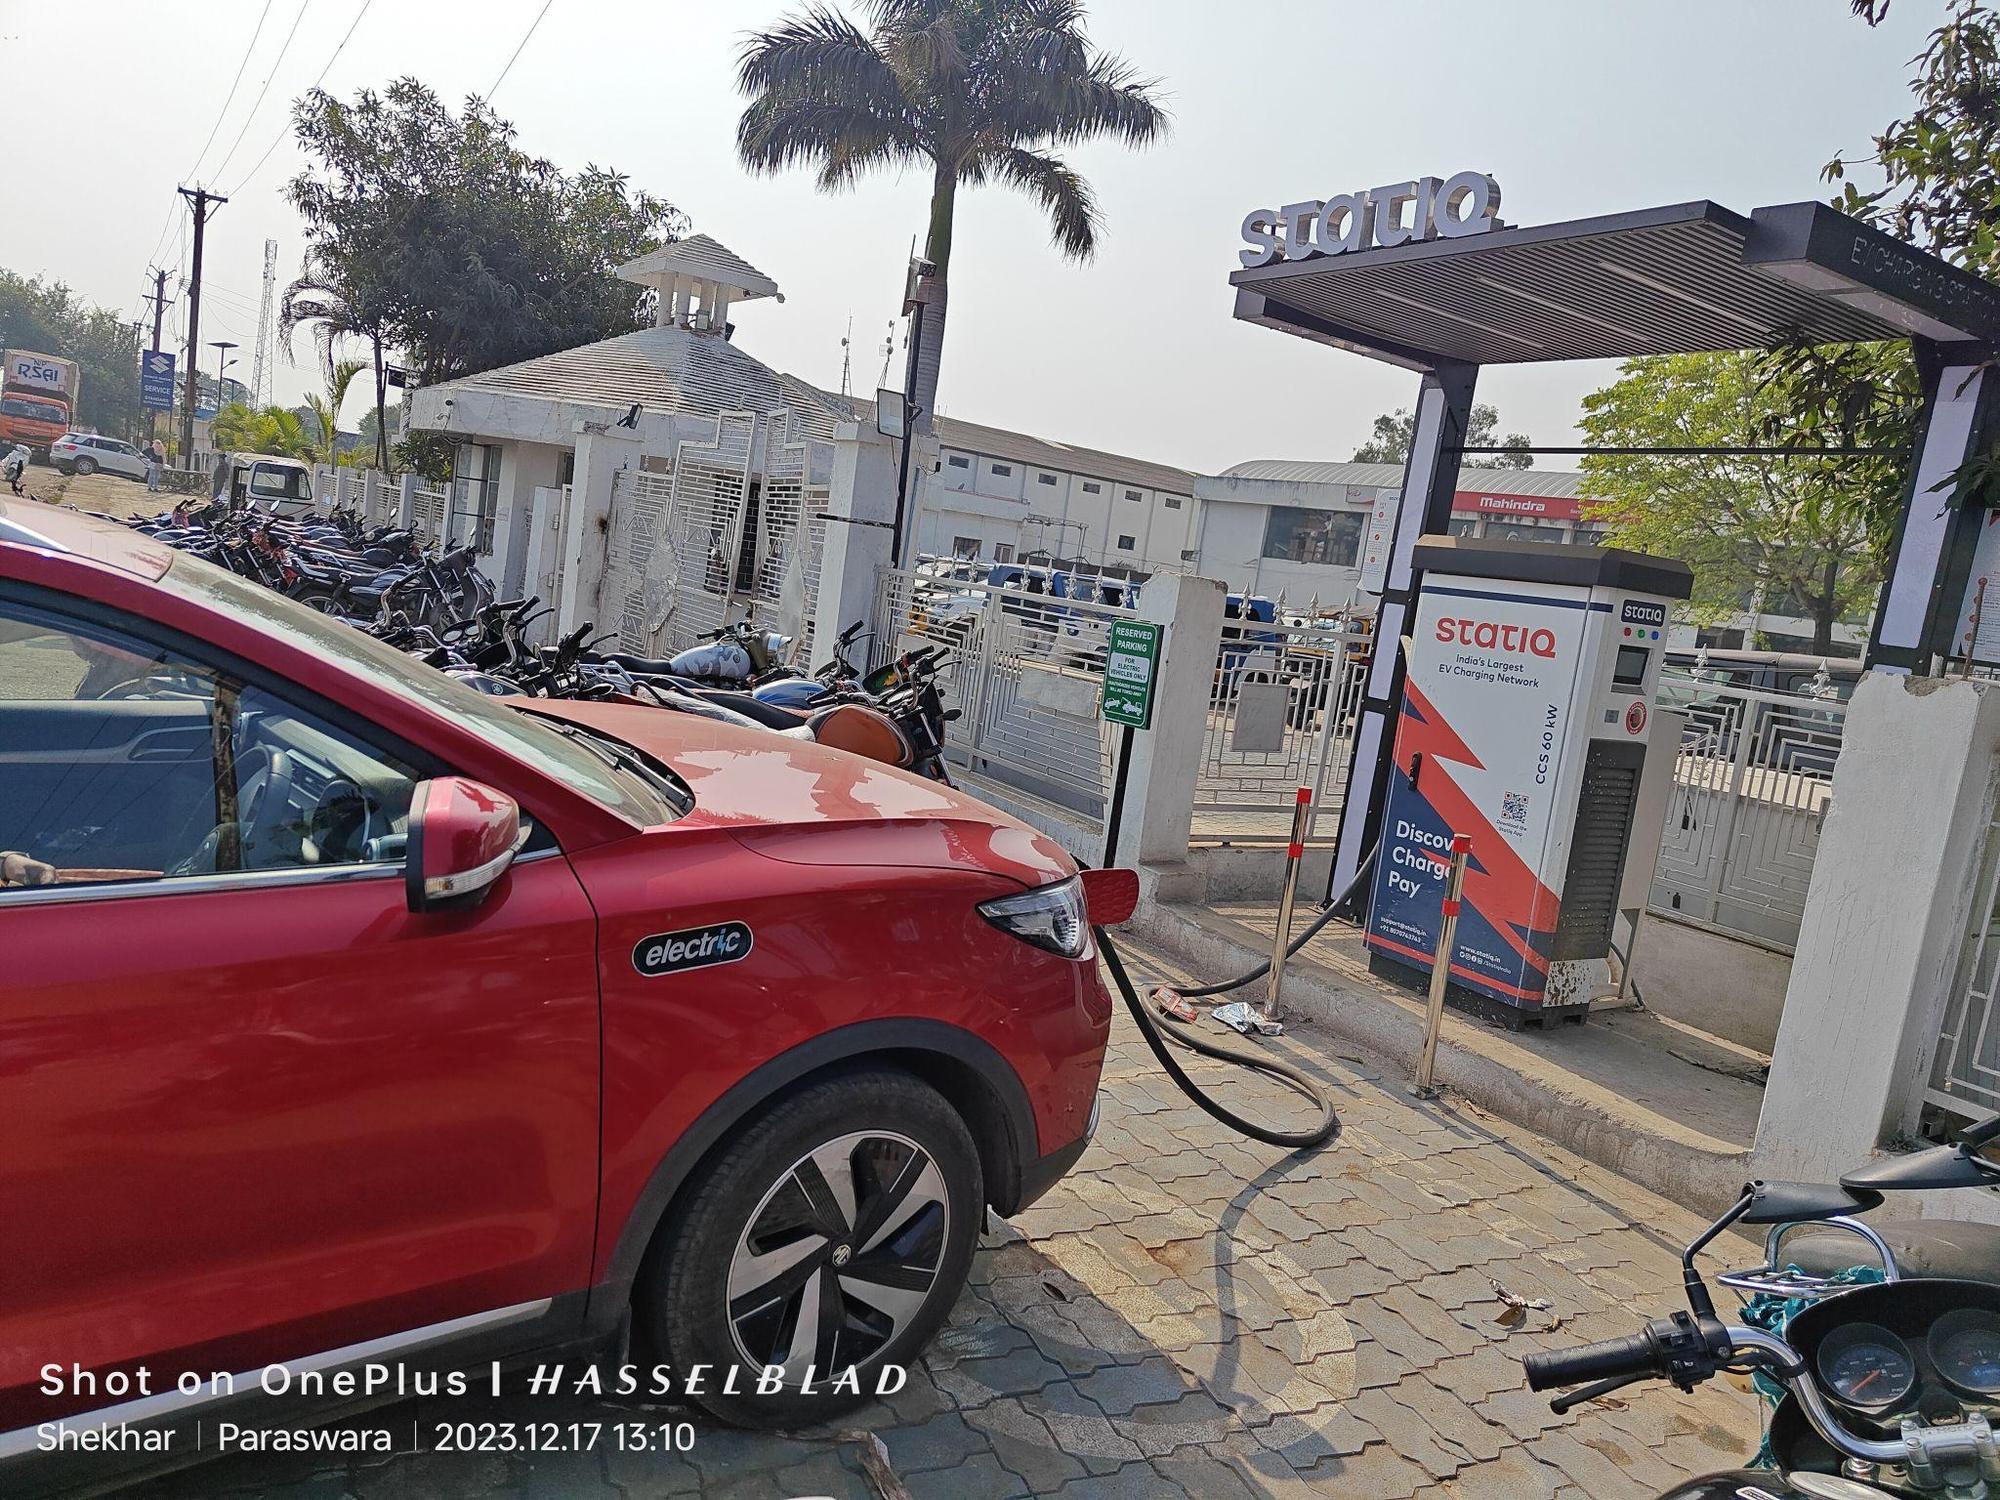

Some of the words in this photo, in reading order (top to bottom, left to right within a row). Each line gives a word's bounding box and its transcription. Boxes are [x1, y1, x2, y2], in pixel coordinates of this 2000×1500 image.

[143, 384, 171, 395] SERVICE
[1480, 496, 1545, 511] Mahindra
[1115, 627, 1153, 640] RESERVED
[1116, 639, 1147, 653] PARKING
[1117, 663, 1141, 672] ELECTRIC
[1456, 654, 1485, 667] India's
[1487, 658, 1524, 672] Largest
[1110, 669, 1132, 679] VEHICLES
[1439, 664, 1452, 673] EV
[1454, 666, 1495, 682] Charging
[1497, 673, 1540, 688] Network
[1545, 704, 1558, 729] kW
[1542, 732, 1553, 751] 60
[1535, 753, 1550, 785] CCS
[1396, 820, 1472, 851] Discov
[1388, 870, 1421, 899] Pay
[645, 928, 741, 966] electric
